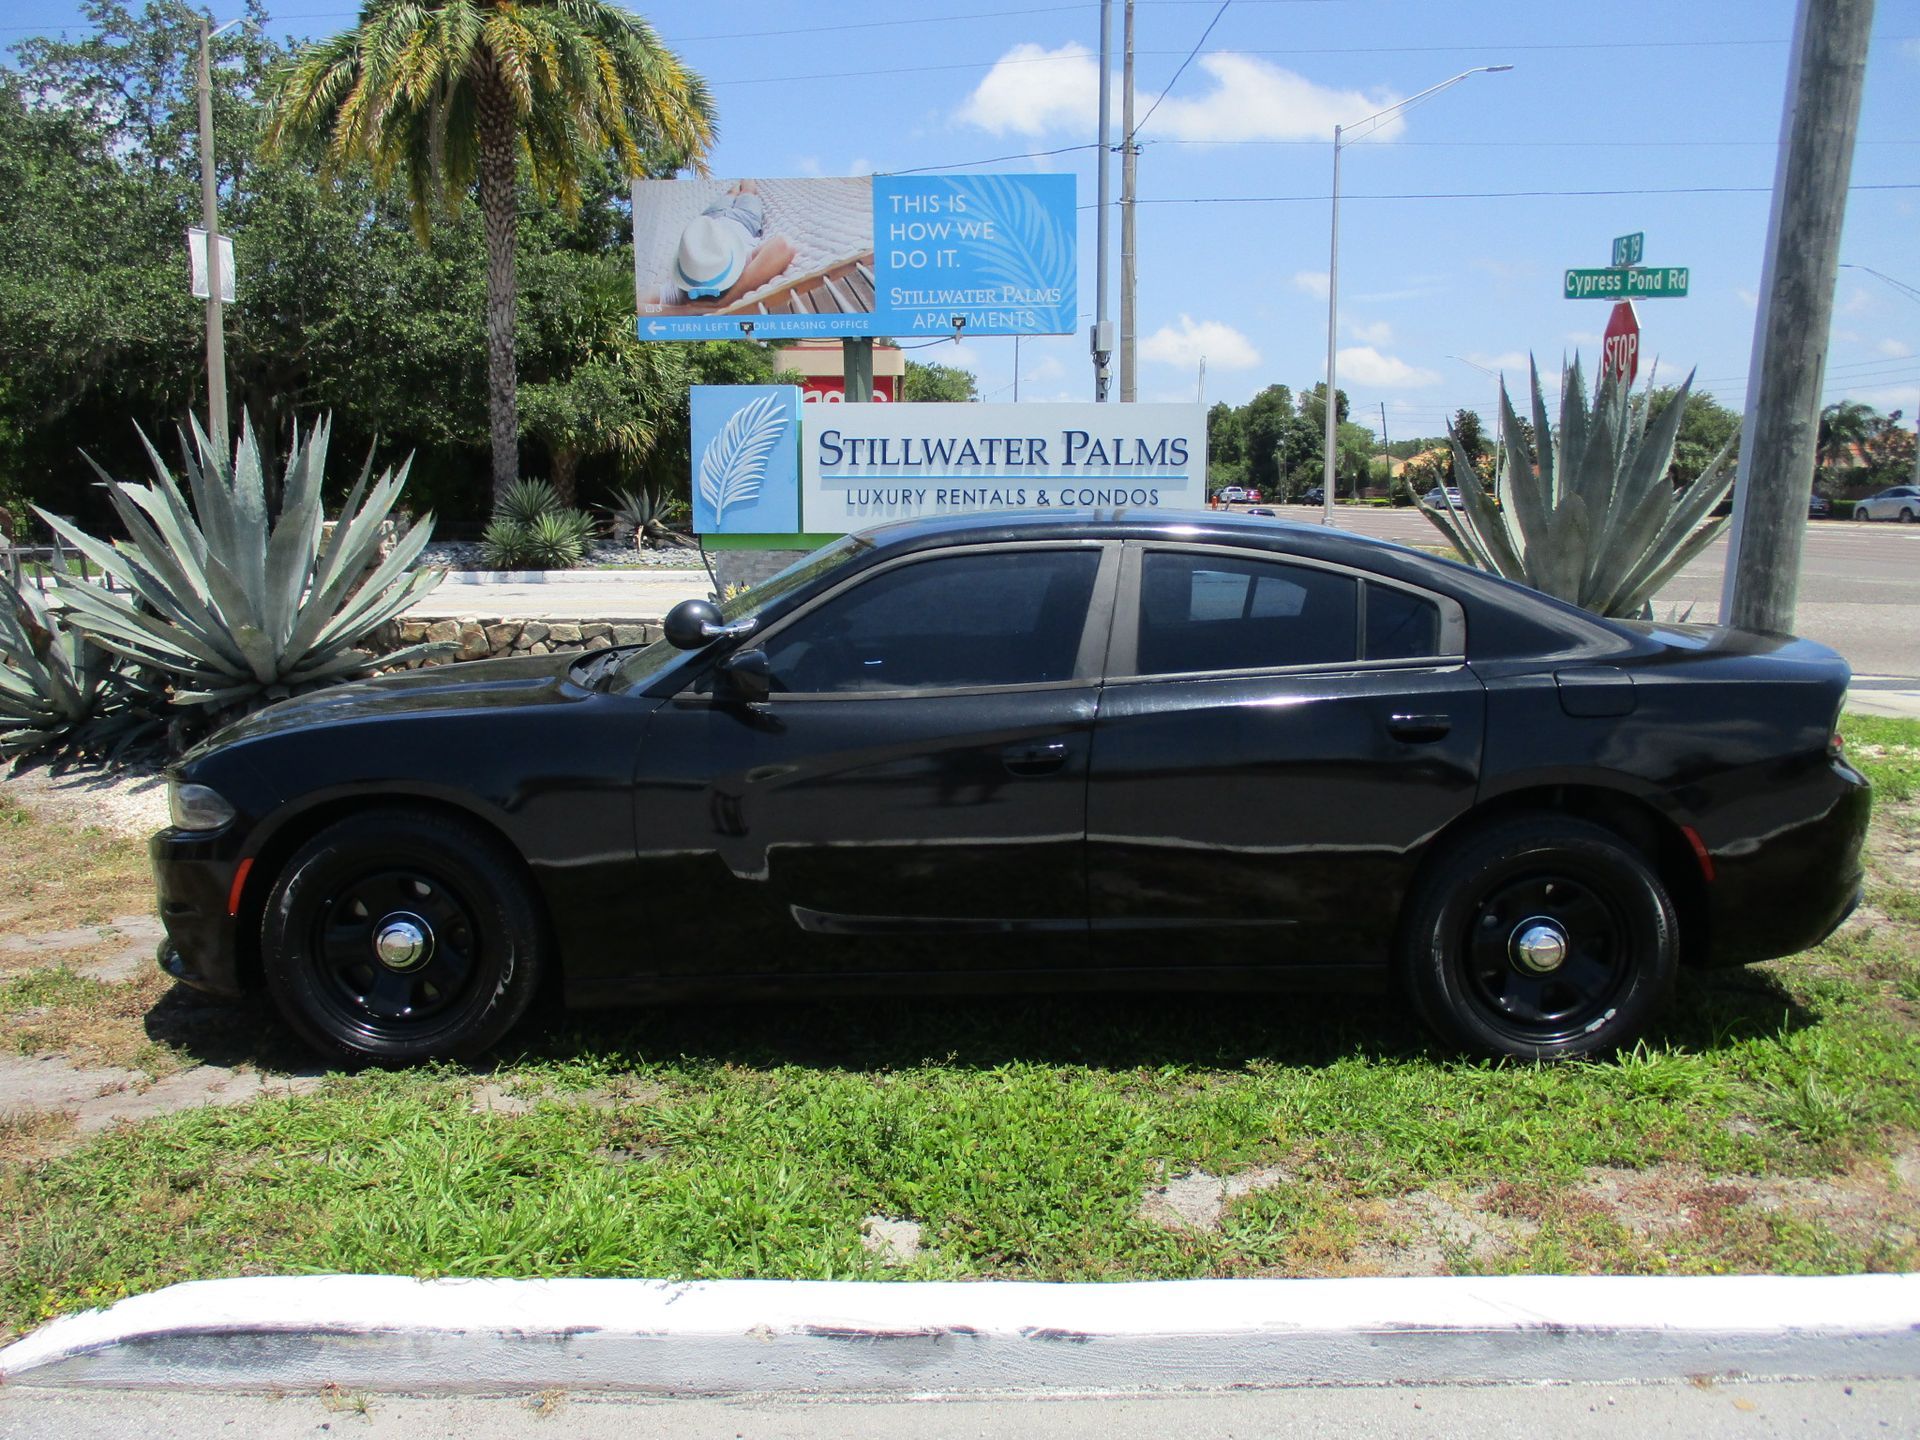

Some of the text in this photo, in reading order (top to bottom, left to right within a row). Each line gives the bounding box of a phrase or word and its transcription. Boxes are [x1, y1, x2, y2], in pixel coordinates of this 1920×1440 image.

[889, 195, 966, 213] THIS IS
[890, 222, 994, 241] HOW WE
[1614, 235, 1641, 264] US 19
[891, 250, 960, 269] DO IT.
[1566, 269, 1686, 297] Cypress Pond Rd
[890, 285, 1061, 305] STILLWATER PALMS
[671, 323, 701, 332] TURN
[705, 322, 730, 331] LEFT
[781, 320, 826, 331] LEASING
[831, 320, 869, 330] OFFICE
[1604, 333, 1636, 371] STOP
[819, 430, 1189, 467] STILLWATER PALMS
[846, 488, 1159, 506] LUXURY RENTALS & CONDOS
